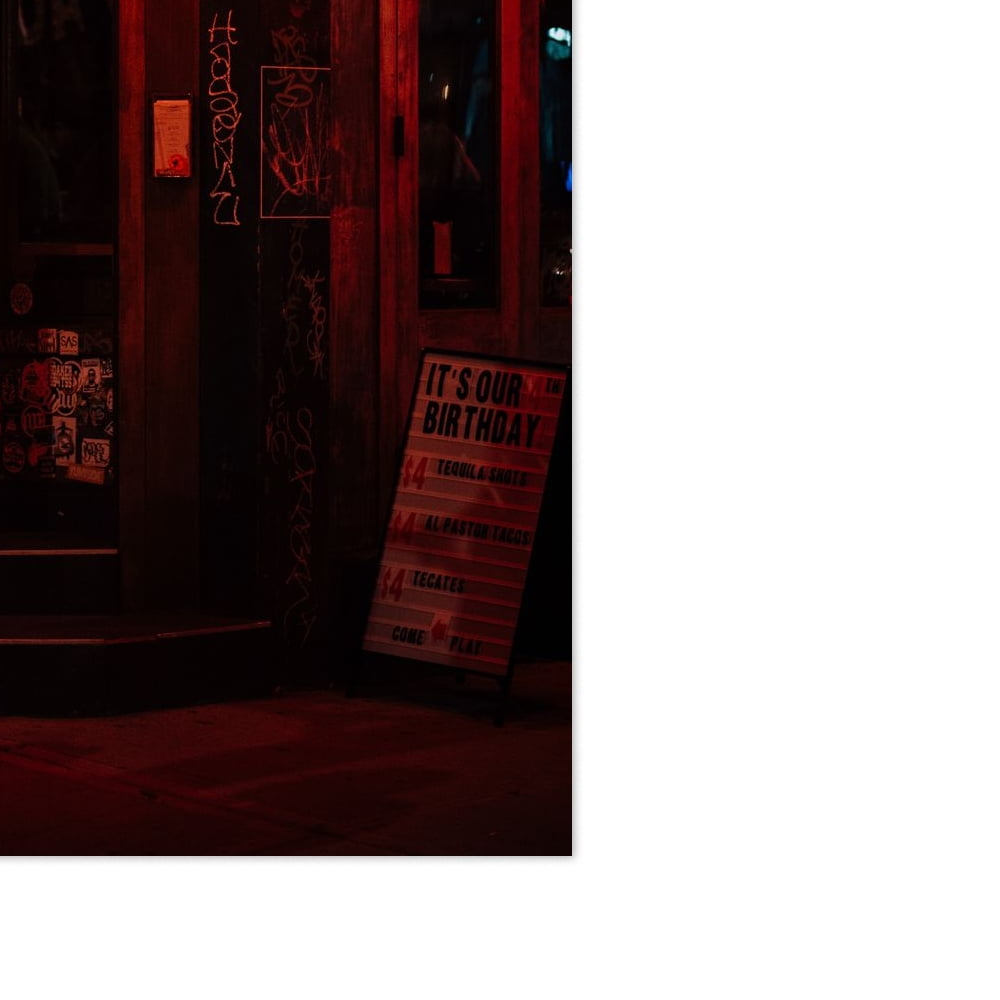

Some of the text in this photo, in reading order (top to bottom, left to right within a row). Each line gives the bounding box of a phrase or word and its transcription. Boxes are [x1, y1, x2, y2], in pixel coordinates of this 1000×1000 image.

[426, 363, 472, 399] IT'S
[475, 370, 523, 408] OUR
[422, 401, 541, 448] BIRTHDAY
[403, 456, 529, 490] $4 TEQUILA SHOTS
[391, 511, 531, 546] $4 AL PASTOR TACOS
[381, 567, 467, 602] $4 TECATES
[392, 626, 426, 646] COME
